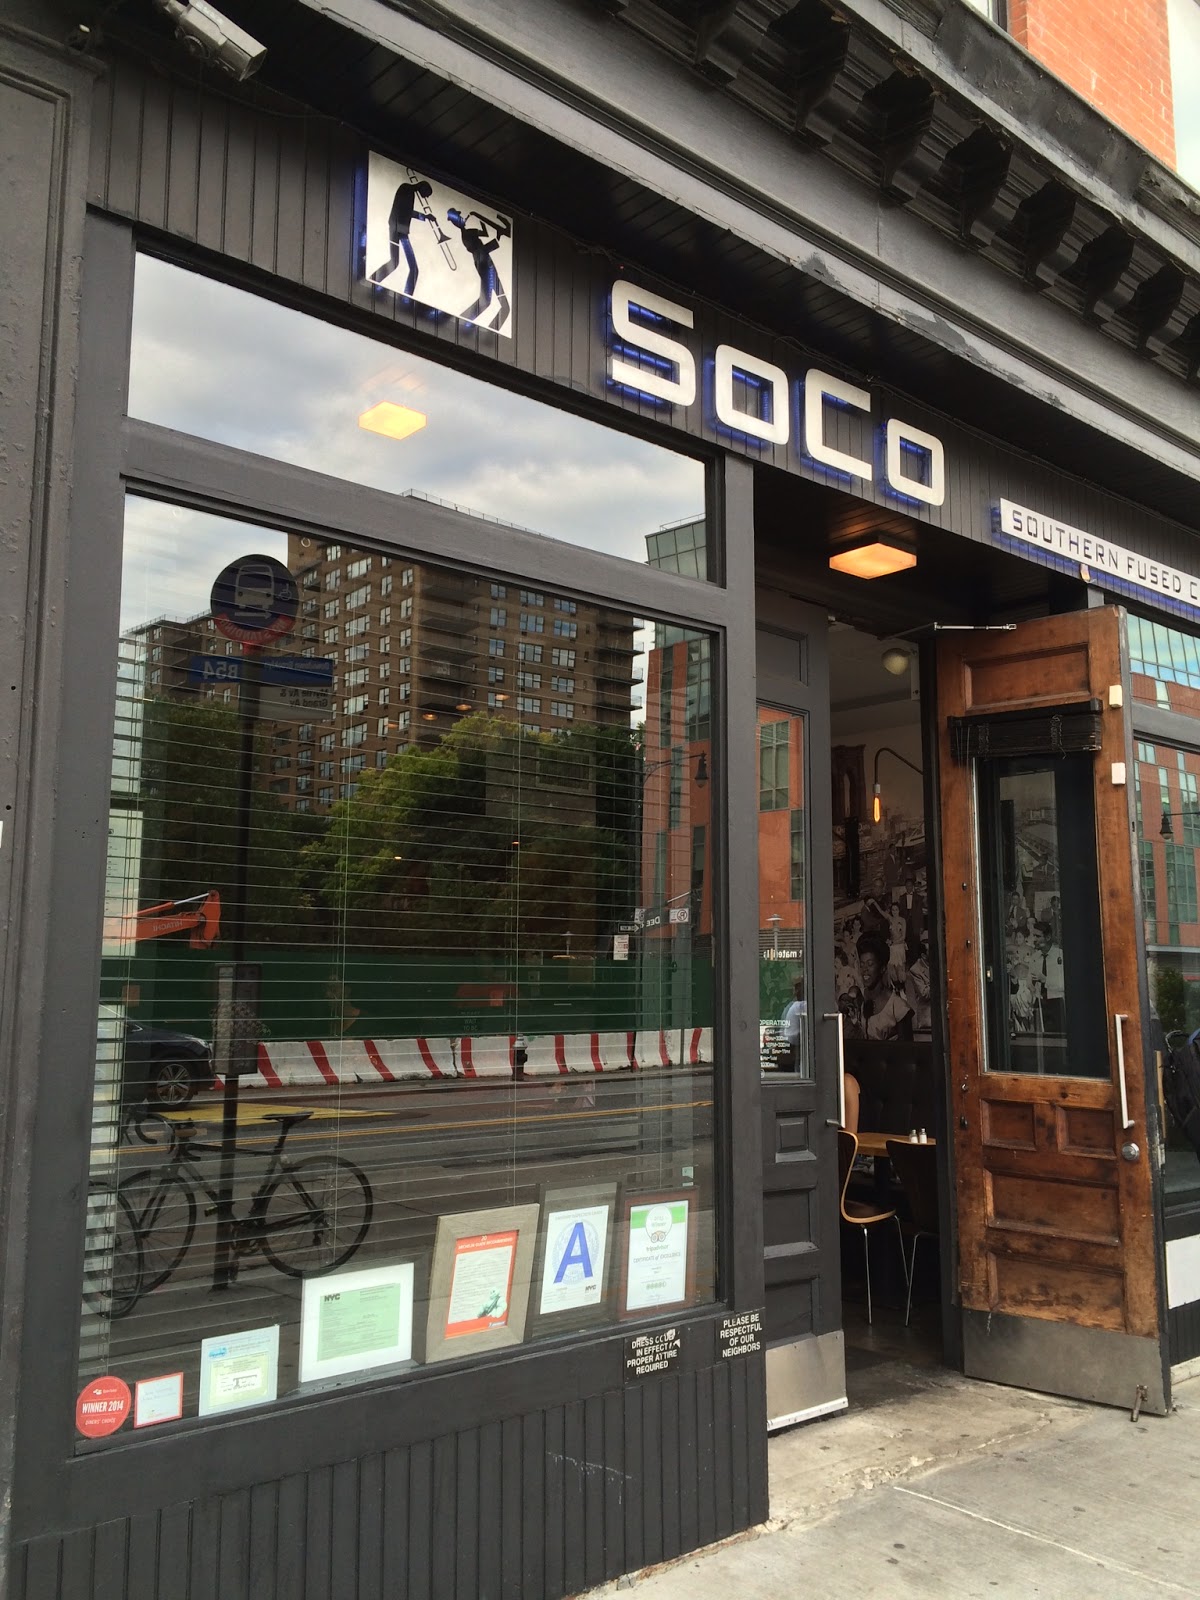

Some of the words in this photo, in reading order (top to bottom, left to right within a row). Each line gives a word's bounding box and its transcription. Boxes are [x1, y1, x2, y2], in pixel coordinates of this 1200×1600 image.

[1012, 509, 1119, 570] SOUTHERN
[1127, 556, 1181, 594] FUSED
[553, 1222, 593, 1283] A
[324, 1293, 341, 1303] NYC
[723, 1315, 750, 1329] PLEASE
[750, 1313, 759, 1323] BE
[720, 1322, 763, 1339] RESPECTFUL
[631, 1337, 654, 1349] DRESS
[729, 1336, 739, 1347] OF
[740, 1333, 755, 1344] OUR
[636, 1348, 643, 1357] IN
[644, 1342, 669, 1355] EFFECT
[722, 1341, 760, 1358] NEIGHBORS
[626, 1355, 654, 1368] PROPER
[655, 1349, 678, 1361] ATTIRE
[636, 1360, 669, 1375] REQUIRED
[82, 1401, 108, 1414] WINNER
[108, 1400, 124, 1412] 2014
